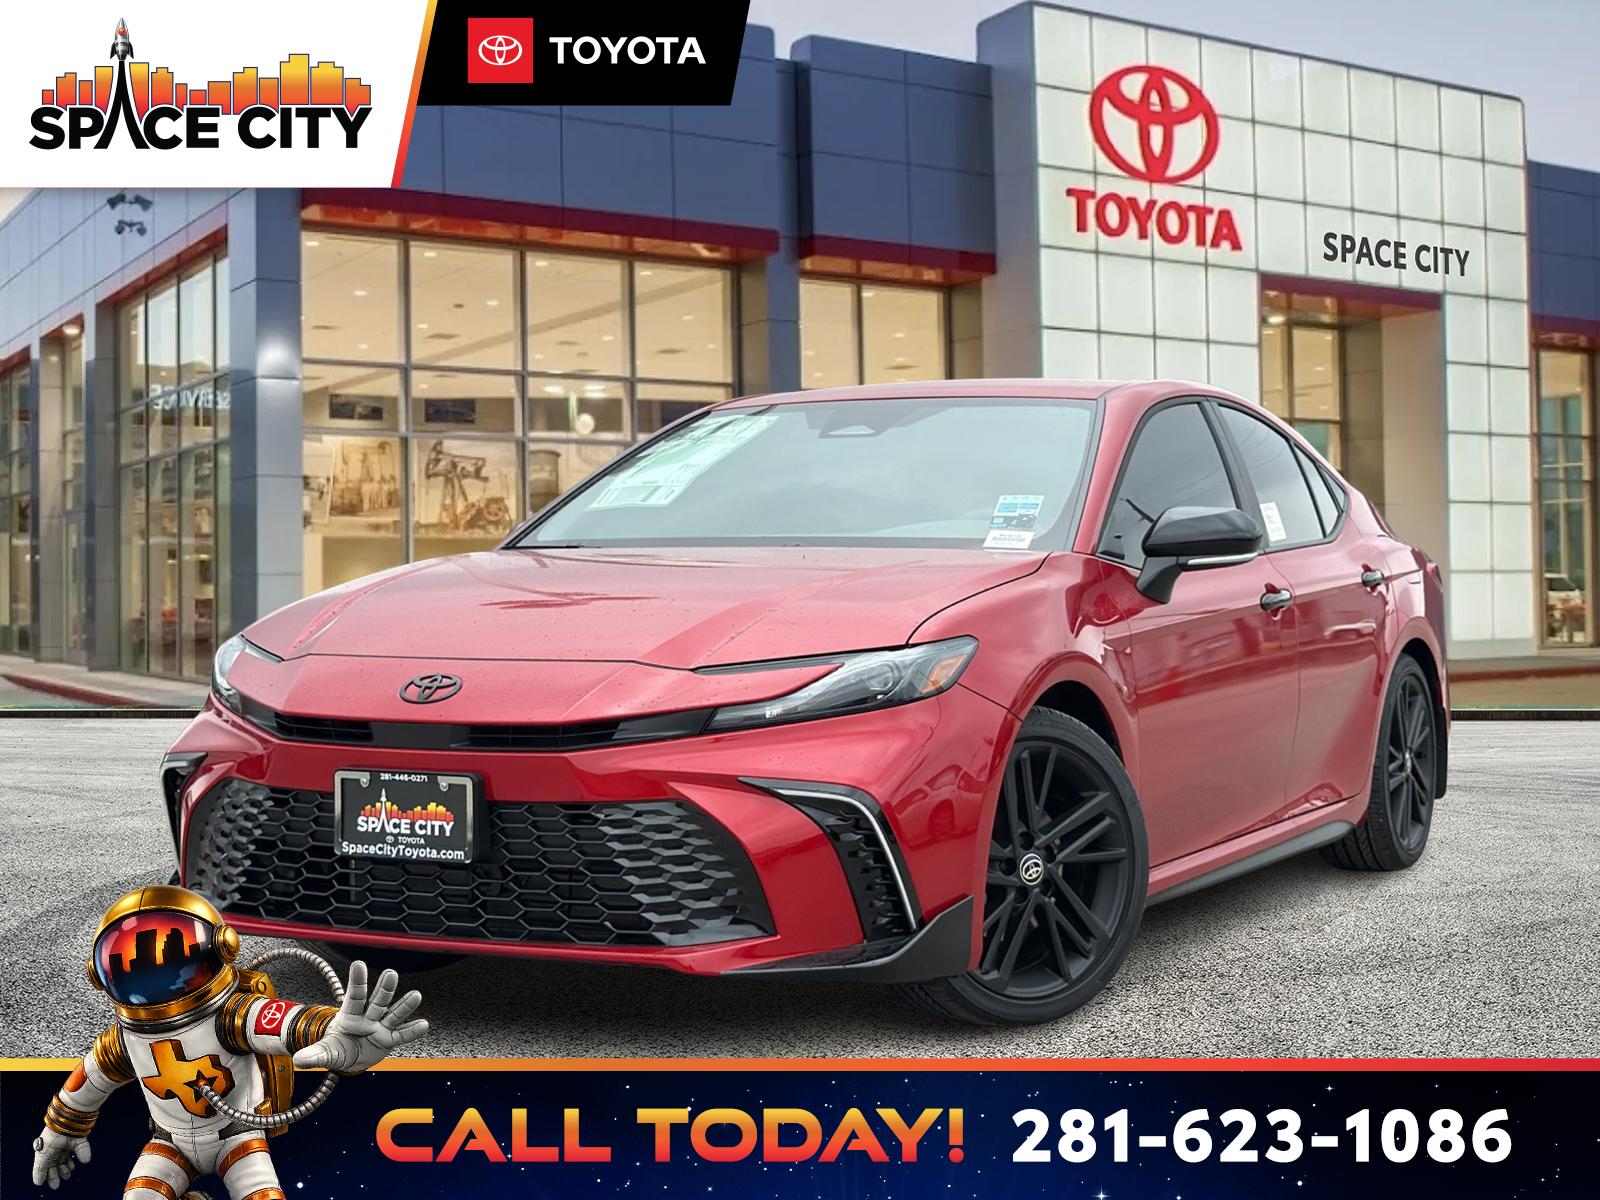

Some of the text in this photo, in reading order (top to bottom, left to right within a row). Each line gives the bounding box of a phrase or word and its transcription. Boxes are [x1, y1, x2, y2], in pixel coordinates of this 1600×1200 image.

[1066, 187, 1242, 251] TOYOTA
[1323, 231, 1470, 277] SPACE CITY
[357, 816, 454, 836] SPACE CITY
[342, 841, 465, 860] SpaceCityToyota.com
[398, 836, 425, 845] TOYOTA
